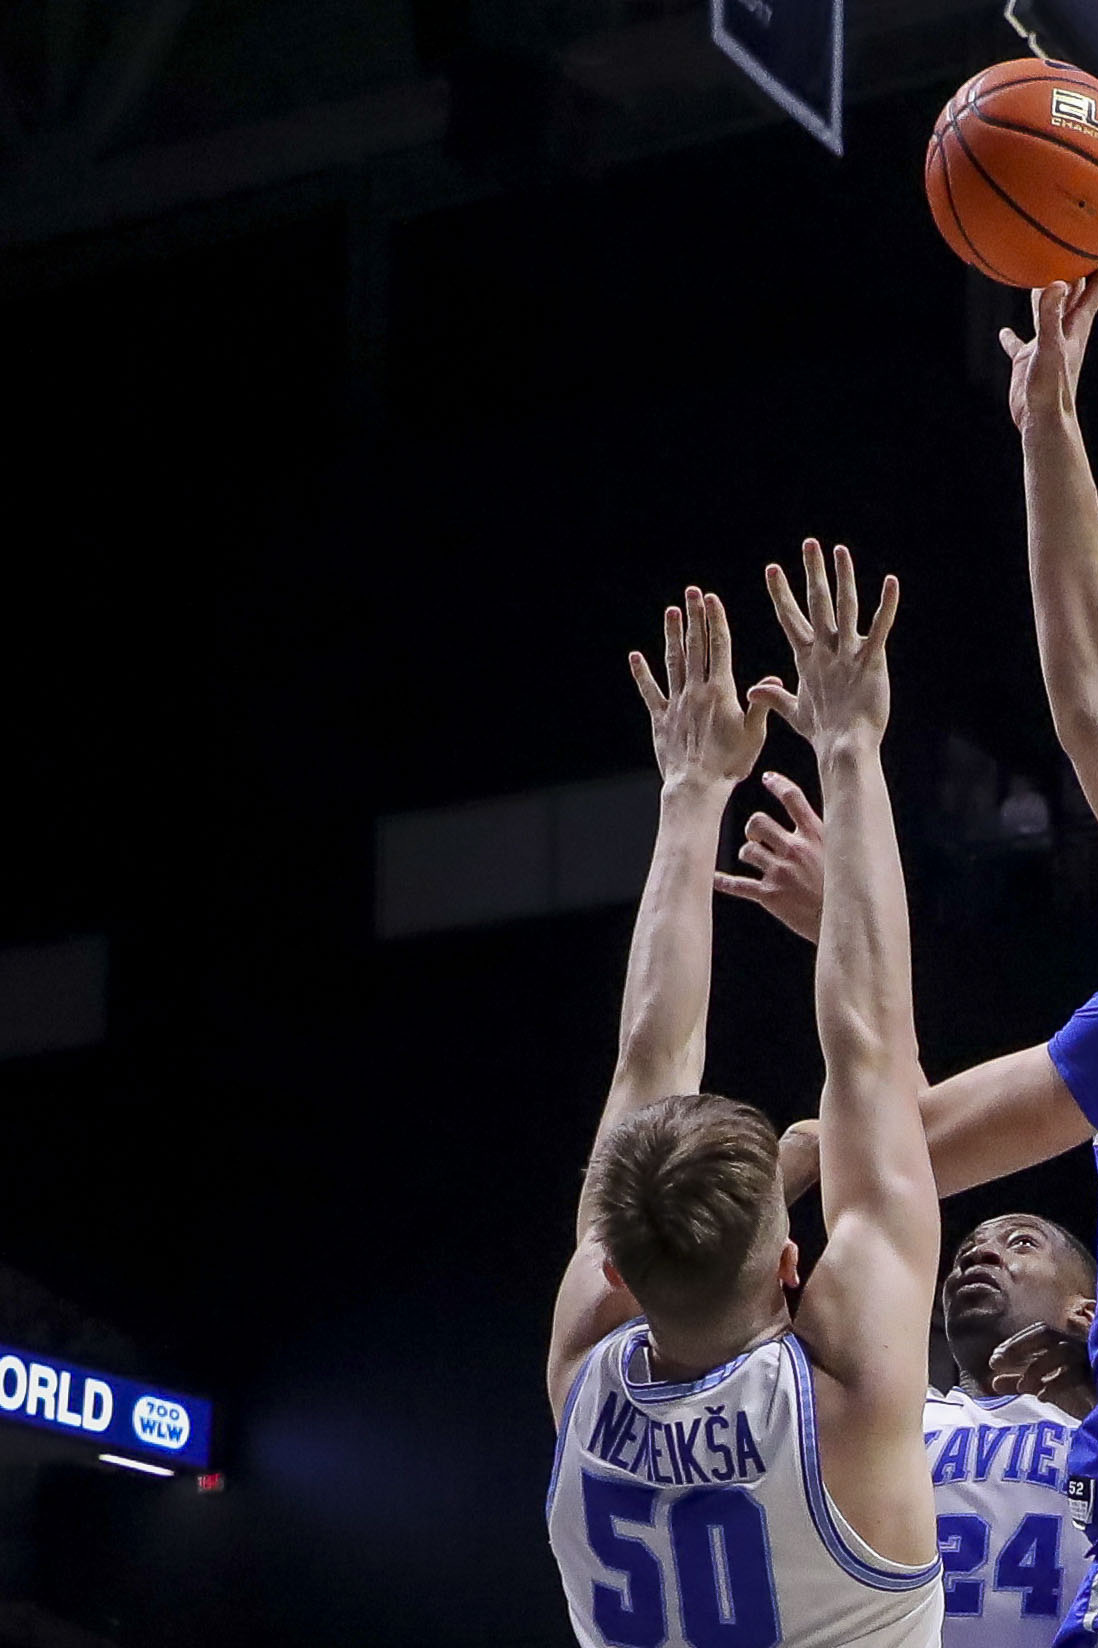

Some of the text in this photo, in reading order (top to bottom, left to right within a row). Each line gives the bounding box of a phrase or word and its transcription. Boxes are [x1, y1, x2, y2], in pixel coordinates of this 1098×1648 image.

[146, 1402, 180, 1421] 700
[140, 1417, 183, 1442] WLW
[924, 1420, 1072, 1496] AVIE
[1069, 1481, 1084, 1495] 52
[937, 1513, 1064, 1618] 24
